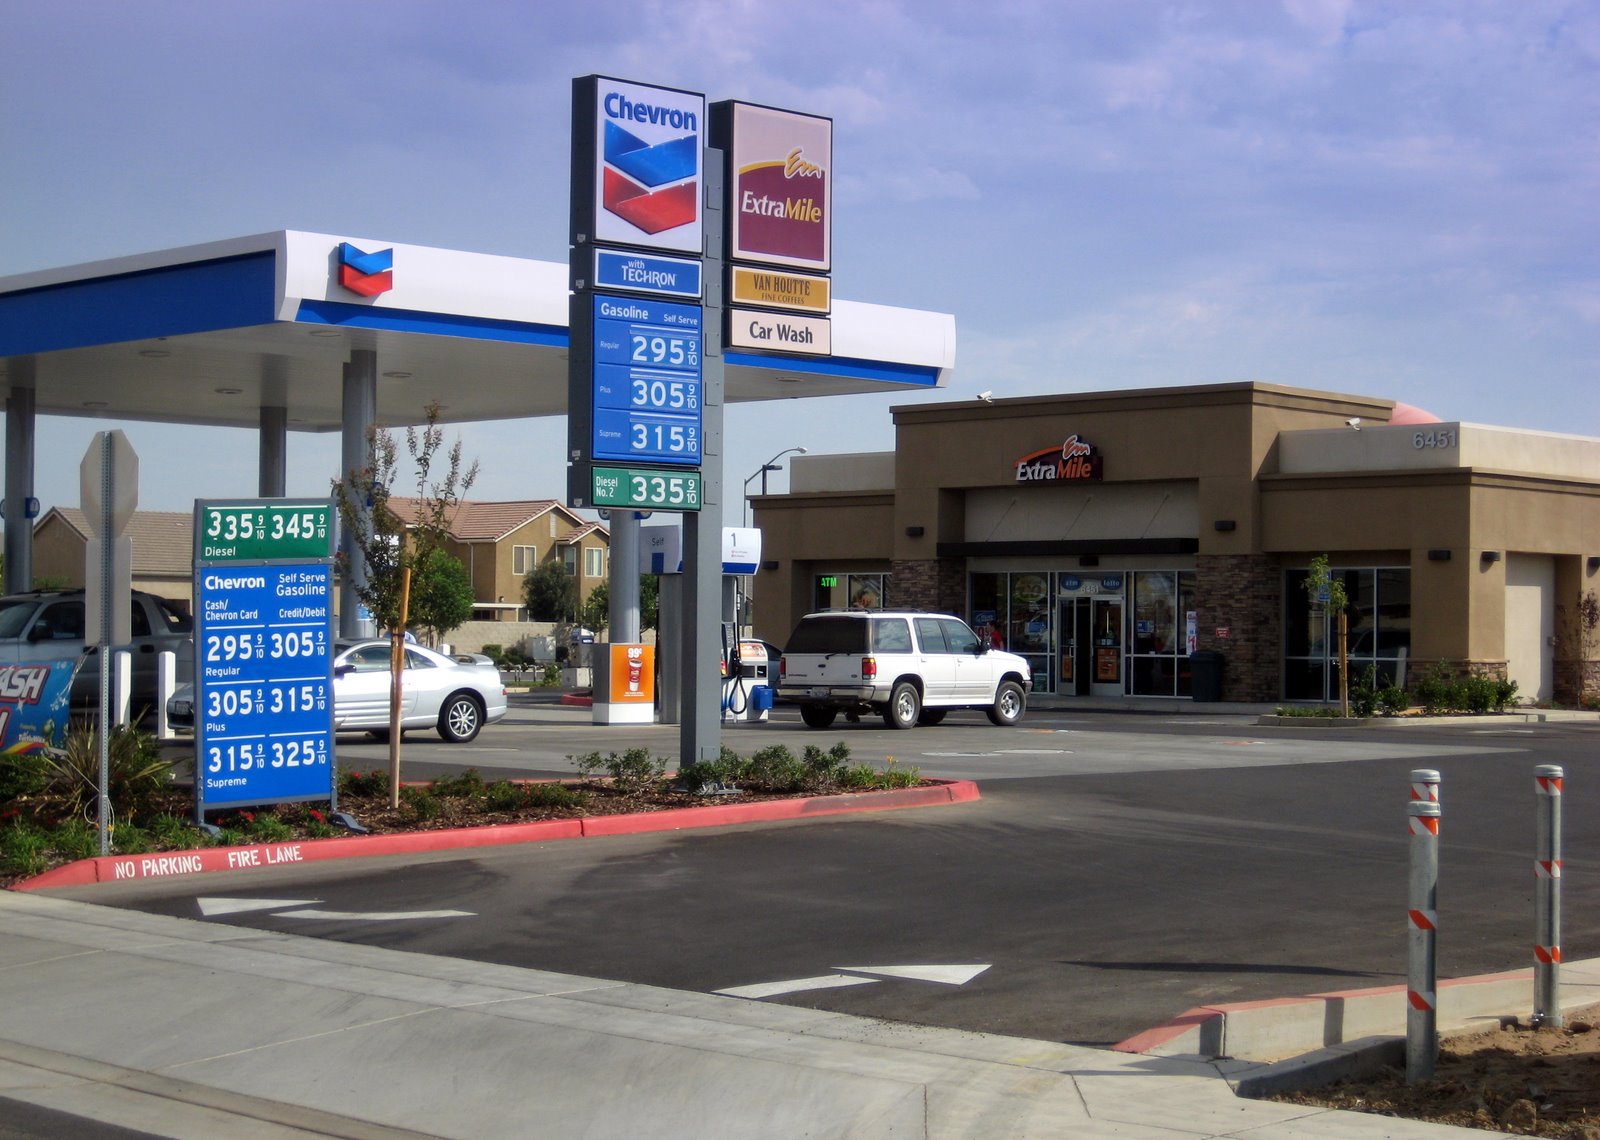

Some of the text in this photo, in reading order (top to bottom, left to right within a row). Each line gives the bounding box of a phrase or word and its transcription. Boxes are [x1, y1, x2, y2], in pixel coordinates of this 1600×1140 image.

[604, 92, 697, 132] Chevron
[741, 190, 822, 223] ExtraMile
[628, 259, 645, 270] with
[622, 265, 676, 288] TECHRON
[754, 273, 810, 296] VAN HOUTTE
[762, 293, 776, 301] FINE
[601, 303, 649, 320] Gasoline
[664, 314, 698, 326] Self Serve
[750, 321, 813, 344] Car Wash
[600, 341, 619, 350] Regular
[632, 336, 684, 364] 295
[600, 386, 611, 394] Plus
[633, 380, 685, 408] 305
[600, 430, 621, 438] Supreme
[632, 424, 684, 452] 315
[1412, 430, 1457, 450] 6451
[1016, 457, 1092, 480] ExtraMile
[596, 476, 618, 487] Diesel
[632, 477, 684, 504] 335
[596, 487, 614, 498] No. 2
[208, 512, 253, 540] 335
[271, 514, 315, 540] 345
[652, 537, 664, 546] Self
[205, 547, 236, 556] Diesel
[205, 576, 265, 590] Chevron
[280, 573, 326, 584] Self Serve
[821, 578, 837, 588] ATM
[277, 584, 326, 597] Gasoline
[206, 599, 228, 610] Cash/
[279, 608, 326, 618] Credit/Debit
[206, 610, 258, 621] Chevron Card
[207, 634, 252, 661] 295
[271, 632, 314, 658] 305
[206, 667, 240, 678] Regular
[0, 667, 47, 699] ASH
[208, 690, 252, 717] 305
[271, 686, 314, 713] 315
[206, 723, 226, 732] Plus
[209, 745, 253, 773] 315
[272, 741, 315, 768] 325
[207, 777, 247, 788] Supreme
[115, 846, 303, 879] NO PARKING FIRE LANE
